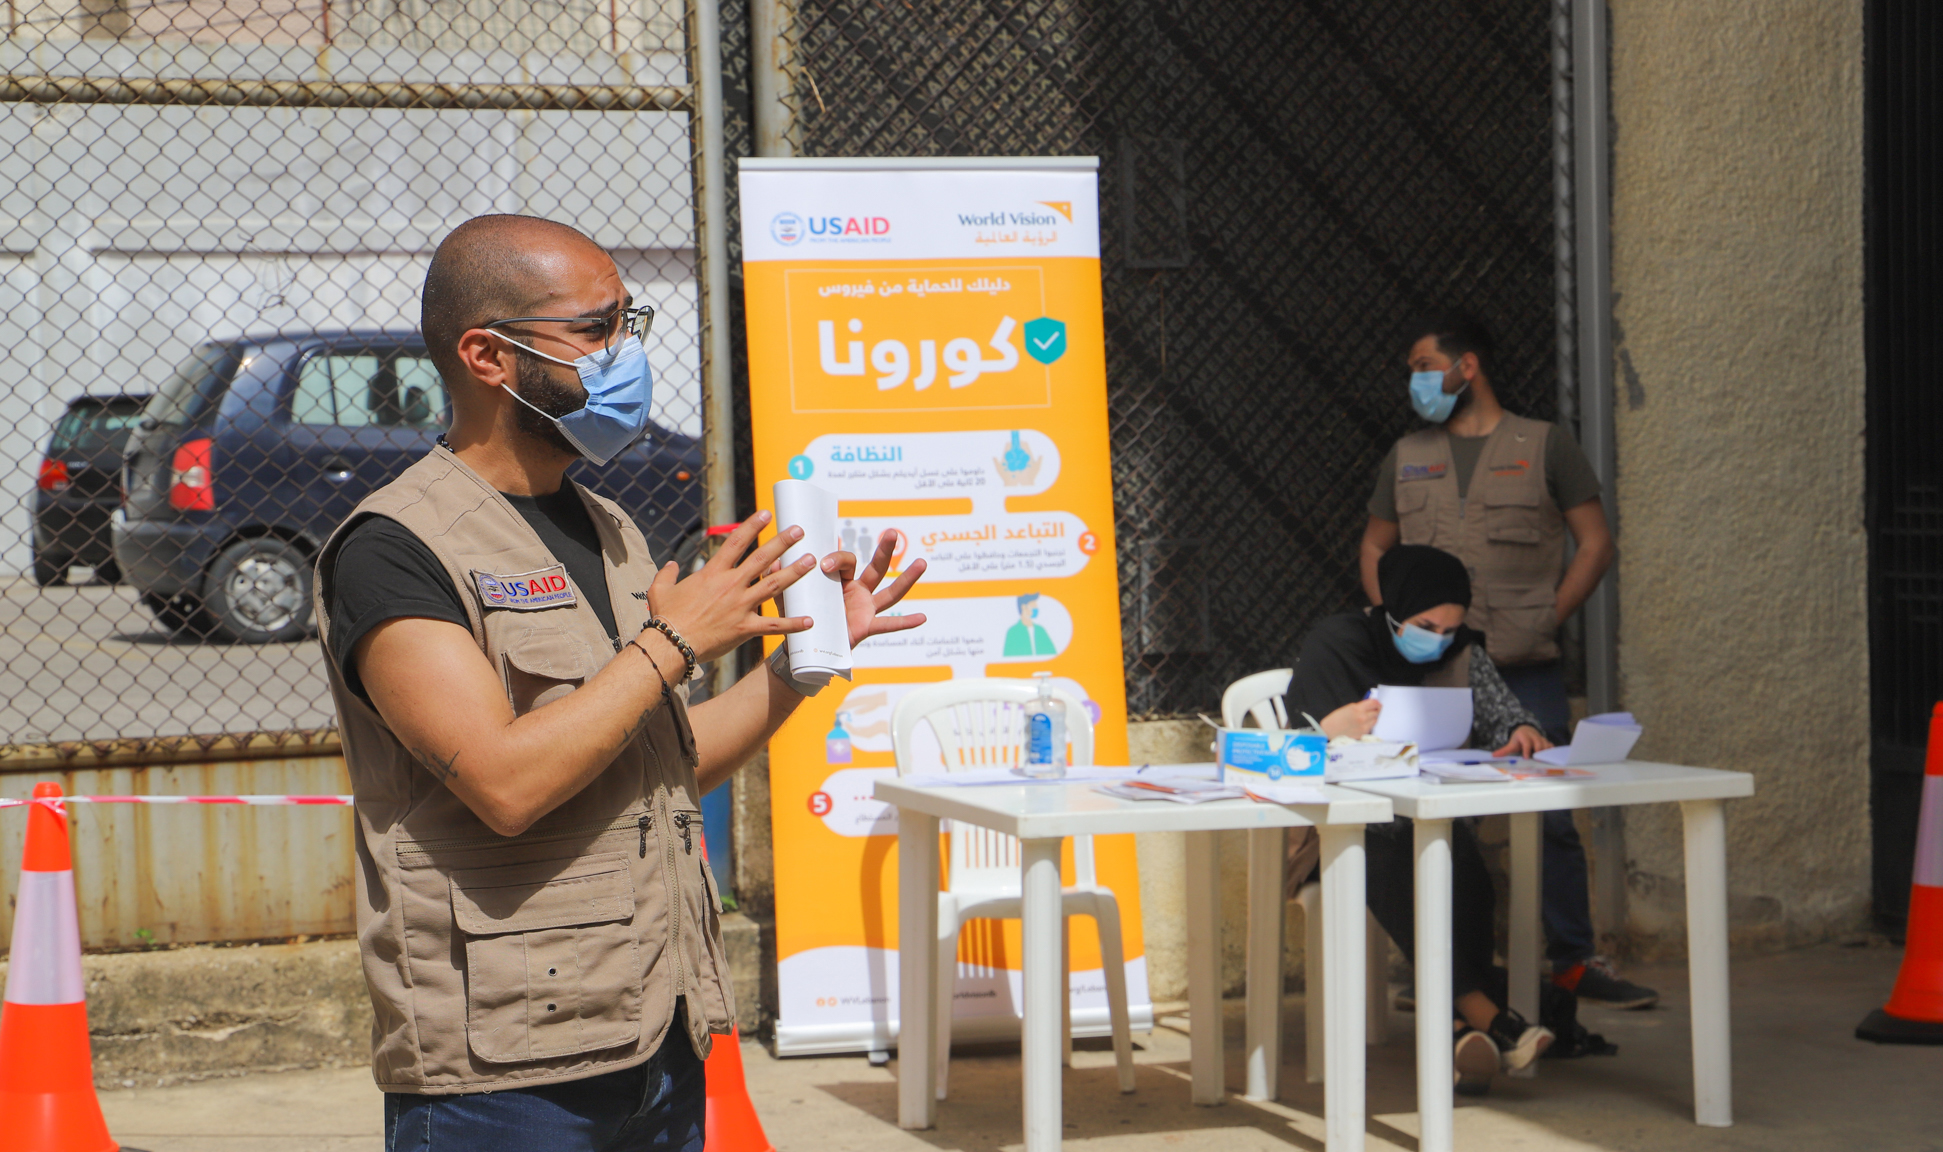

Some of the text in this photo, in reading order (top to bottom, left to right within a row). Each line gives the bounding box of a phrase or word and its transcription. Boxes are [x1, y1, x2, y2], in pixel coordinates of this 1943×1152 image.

[808, 216, 891, 235] USAID
[957, 211, 1057, 226] World Vision
[818, 277, 1011, 297] دليلك للحماية من فيروس
[818, 315, 1020, 391] كورونا
[830, 445, 903, 462] النظافة
[795, 460, 805, 475] 1
[920, 522, 1065, 552] التباعد الجسدي
[1083, 535, 1096, 550] 2
[500, 575, 566, 597] USAID
[530, 594, 555, 603] AMERICAN
[554, 591, 572, 600] PEOPLE
[813, 794, 828, 814] 5
